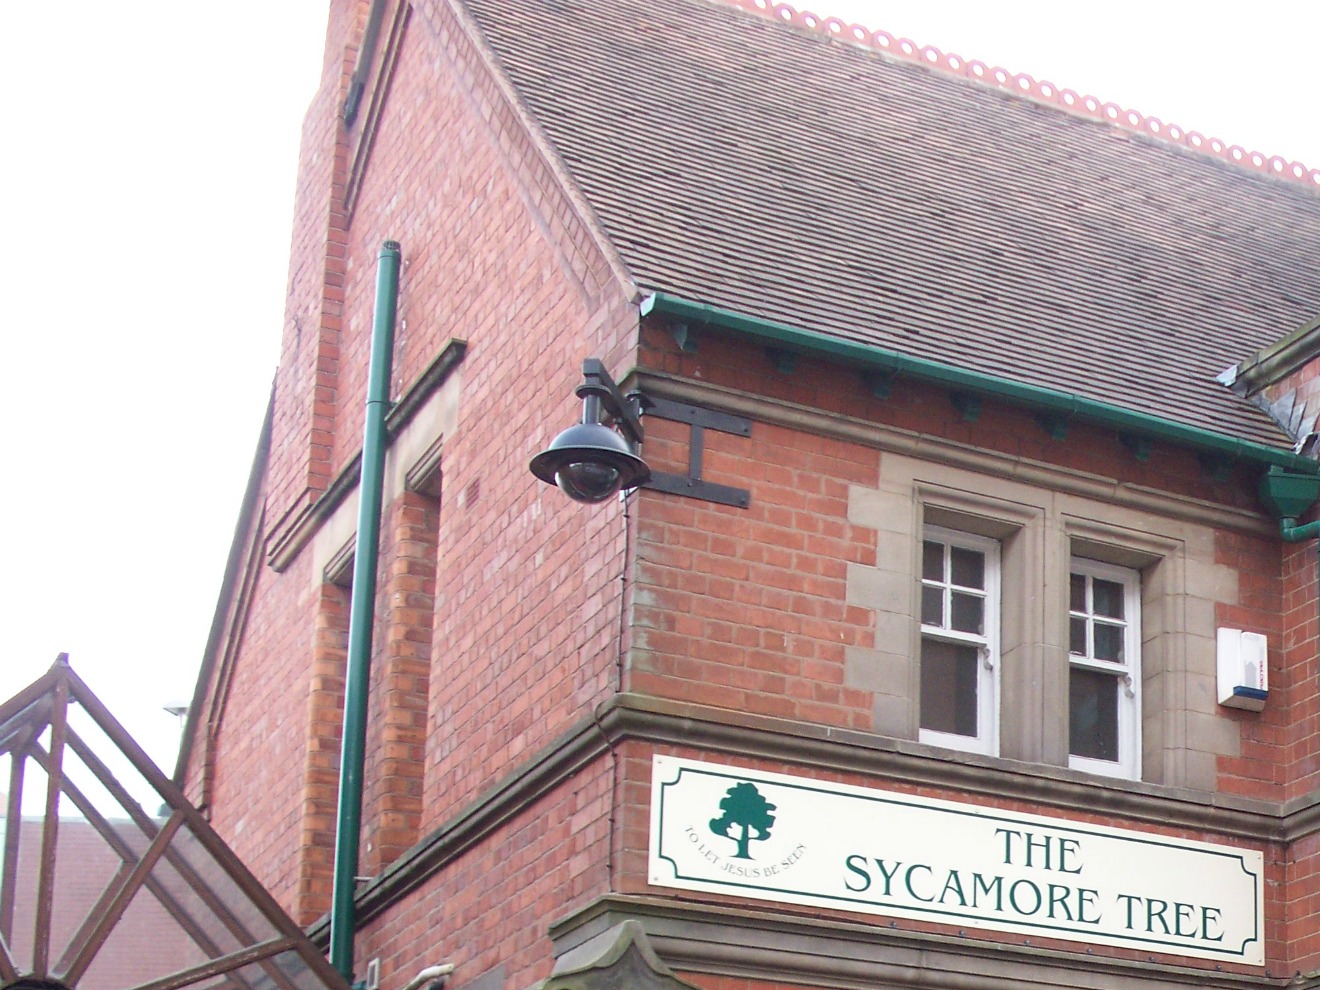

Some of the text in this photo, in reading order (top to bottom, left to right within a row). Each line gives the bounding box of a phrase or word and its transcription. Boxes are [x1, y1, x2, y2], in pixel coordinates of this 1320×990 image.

[684, 825, 807, 878] TO LET JESUS BE SEEN
[995, 828, 1082, 875] THE
[844, 854, 1226, 943] SYCAMORE TREE
